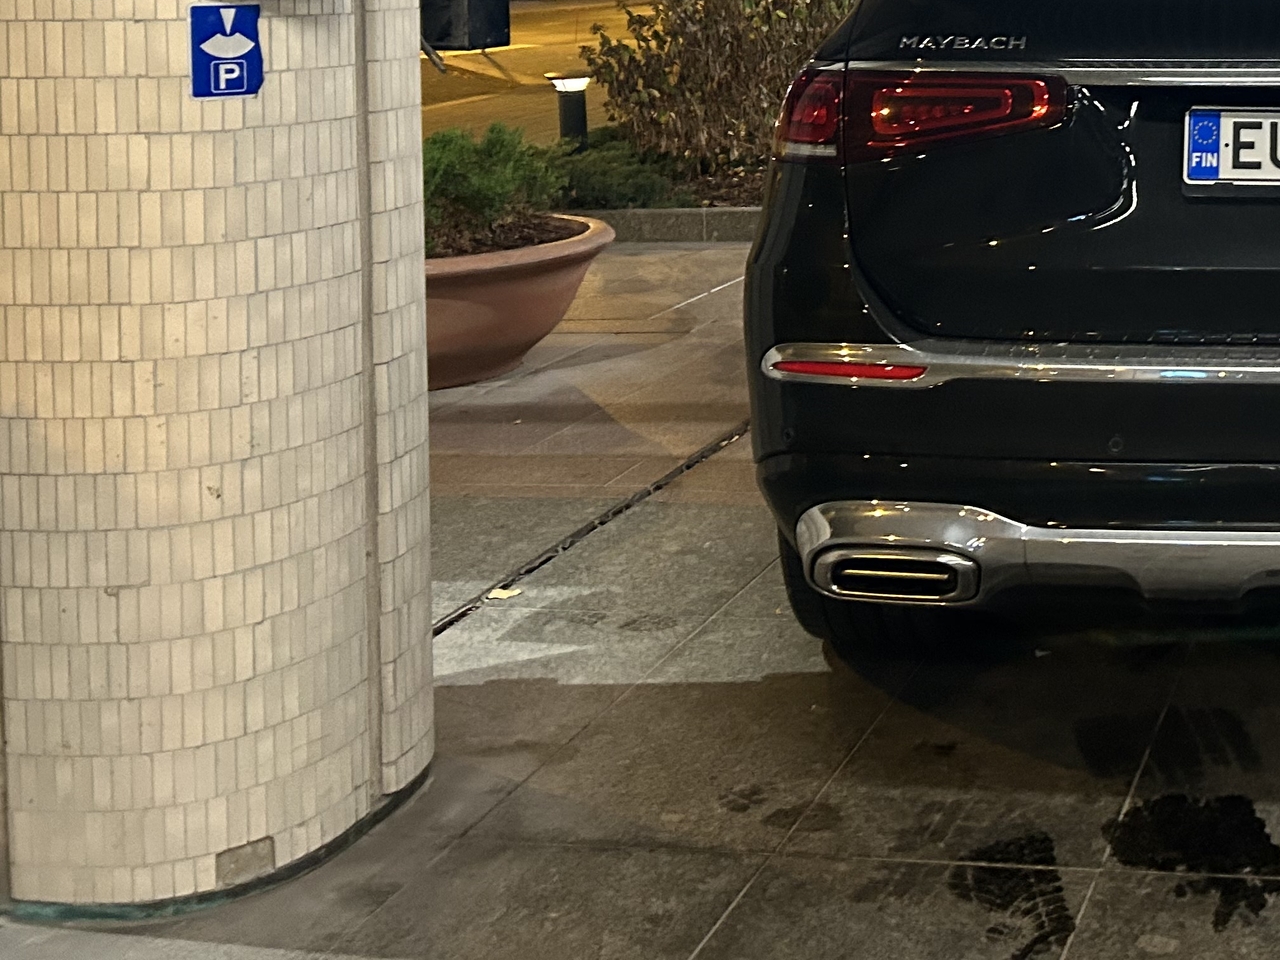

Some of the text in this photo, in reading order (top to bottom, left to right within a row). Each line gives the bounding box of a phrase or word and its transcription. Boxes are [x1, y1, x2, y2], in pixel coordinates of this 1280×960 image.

[899, 35, 1027, 49] MAYBACH
[219, 63, 240, 90] P
[1191, 152, 1218, 168] FIN
